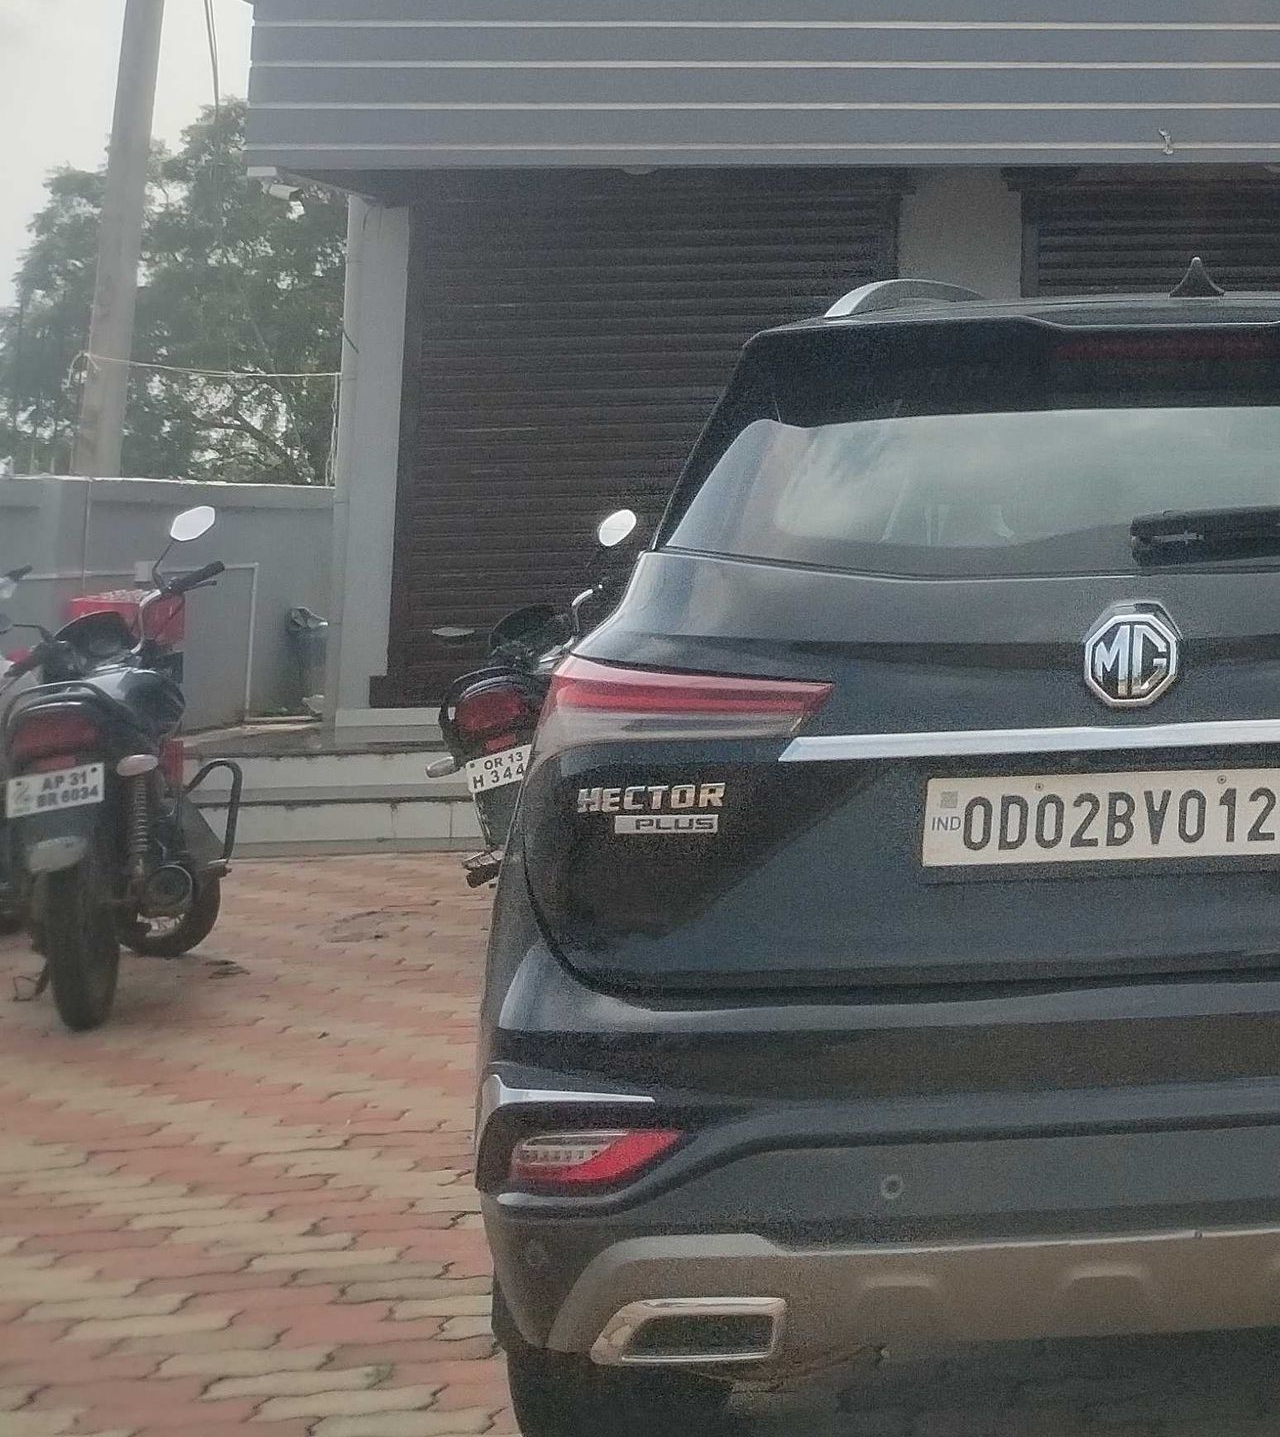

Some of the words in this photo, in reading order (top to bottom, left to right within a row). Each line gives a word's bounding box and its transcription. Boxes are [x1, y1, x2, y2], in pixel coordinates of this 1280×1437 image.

[1094, 624, 1167, 696] MG
[484, 758, 503, 770] OR
[508, 752, 523, 763] 13
[42, 775, 65, 791] AP
[70, 770, 87, 786] 31
[473, 774, 484, 789] H
[577, 782, 726, 813] HECTOR
[635, 818, 714, 831] PLUS
[931, 816, 961, 832] IND
